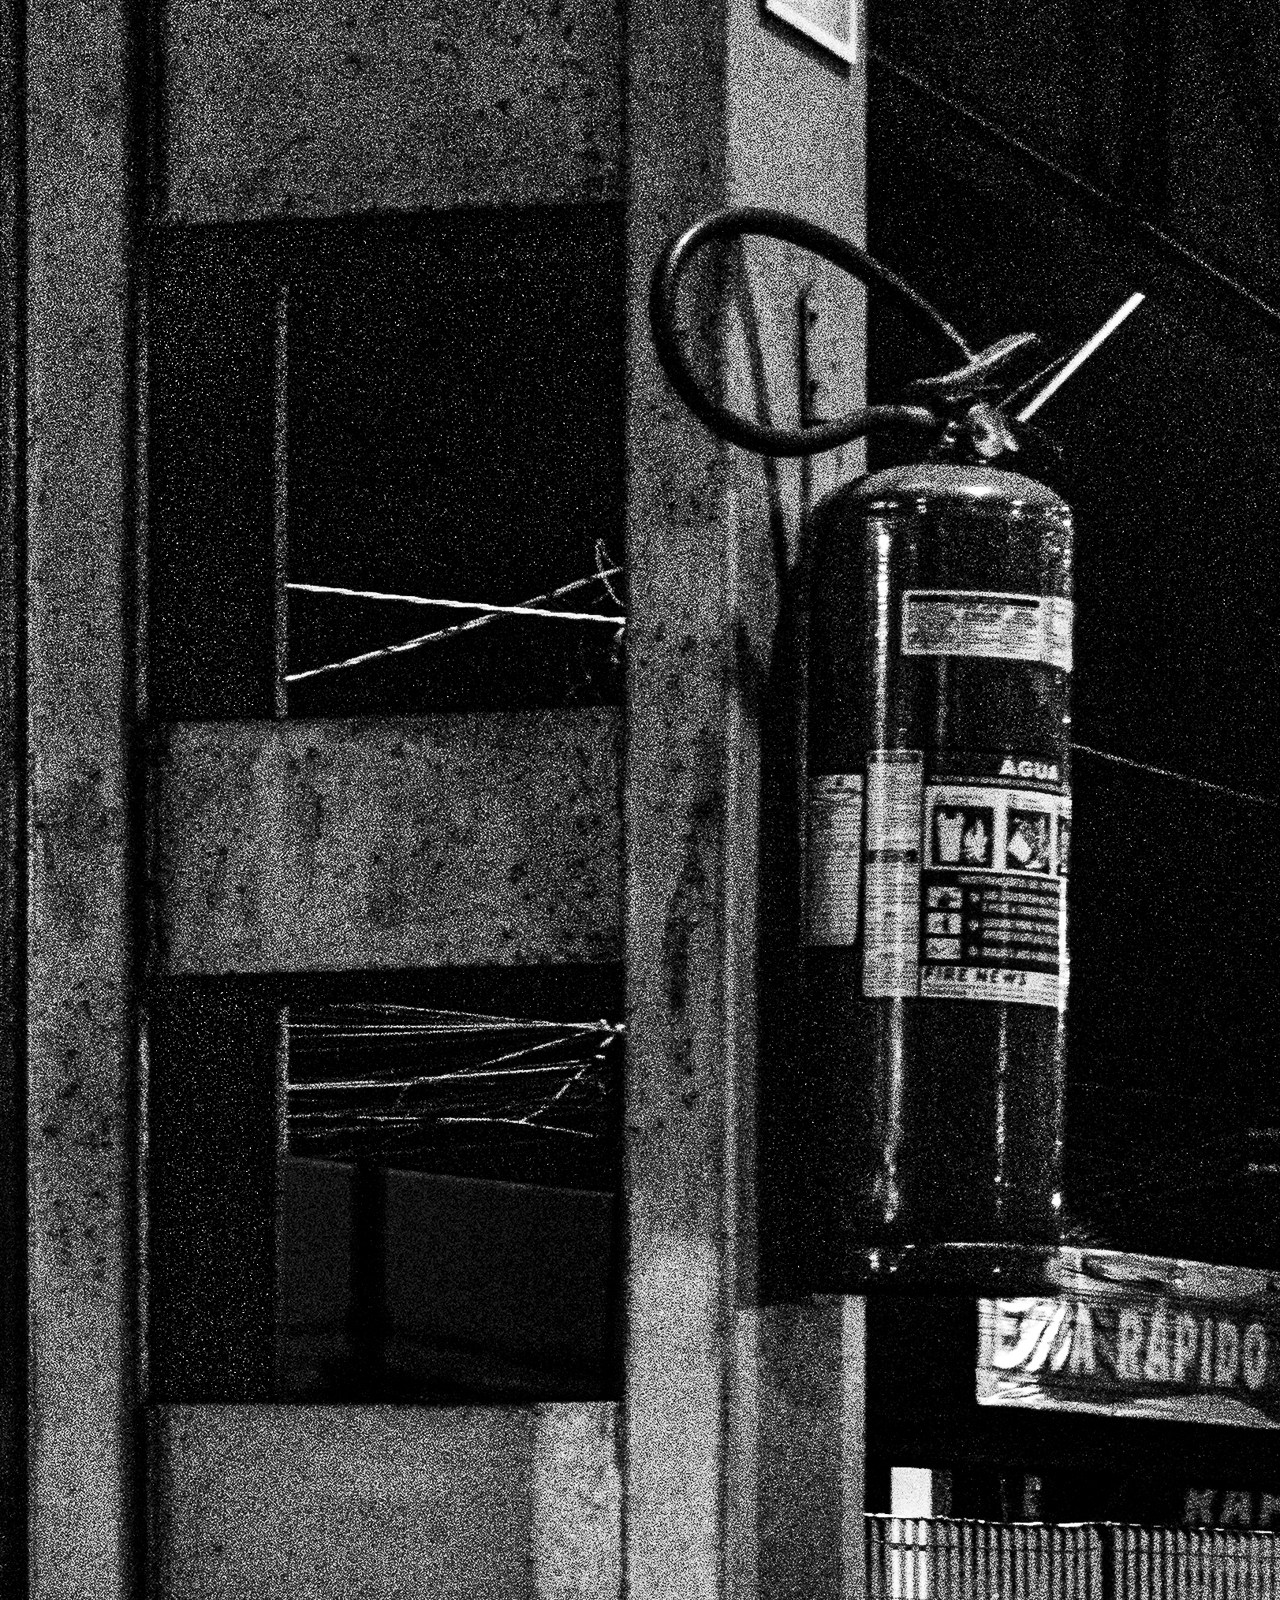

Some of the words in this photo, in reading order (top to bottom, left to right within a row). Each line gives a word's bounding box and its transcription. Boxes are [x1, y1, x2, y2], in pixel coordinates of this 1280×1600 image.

[999, 756, 1059, 780] ÁGUA
[924, 967, 968, 982] FIRE
[975, 968, 1026, 986] NEWS
[1116, 1300, 1268, 1390] RÁPIDO
